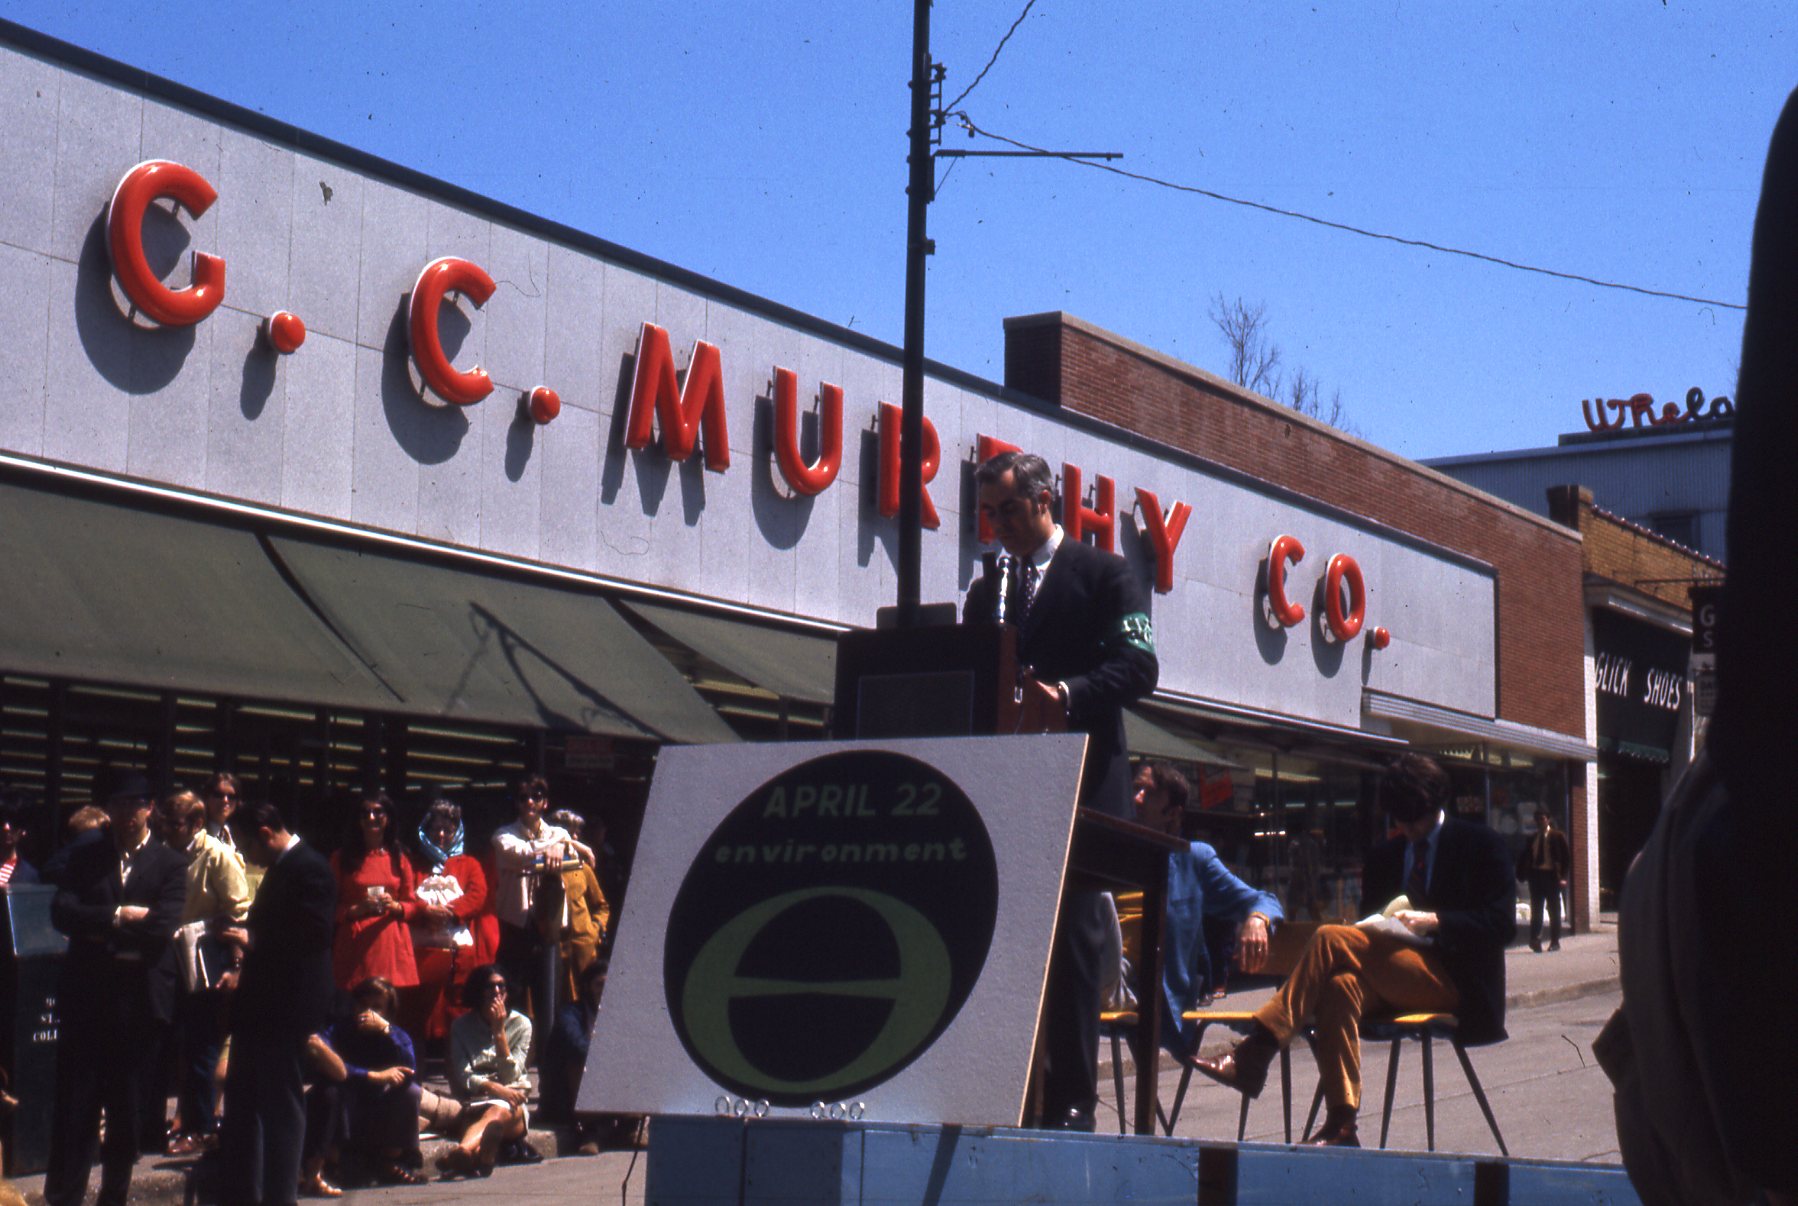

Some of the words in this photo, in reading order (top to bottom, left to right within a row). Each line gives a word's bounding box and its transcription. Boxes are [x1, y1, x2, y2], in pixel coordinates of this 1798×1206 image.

[408, 256, 561, 425] C.
[1268, 534, 1391, 650] CO.
[1595, 652, 1632, 697] GLICK
[1643, 668, 1683, 710] SHOES
[762, 783, 876, 818] APRIL
[890, 781, 943, 817] 22
[714, 837, 968, 864] environment
